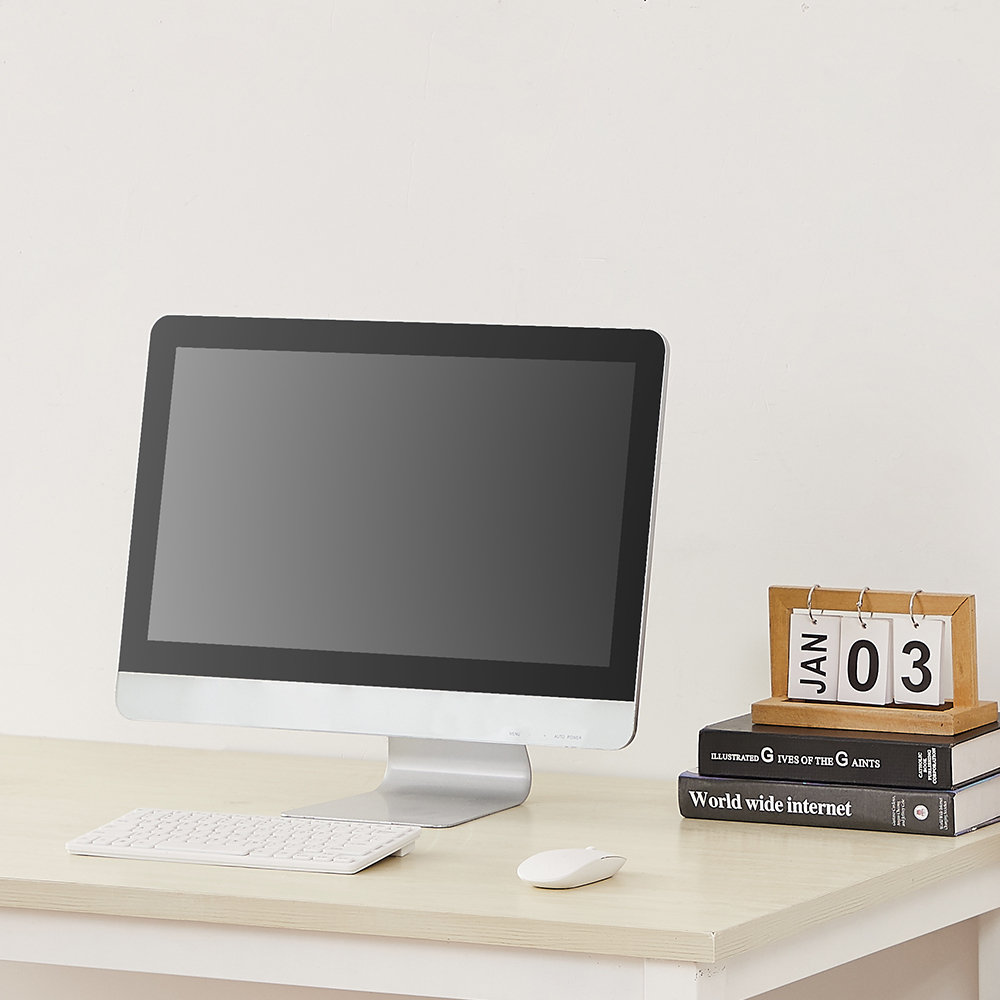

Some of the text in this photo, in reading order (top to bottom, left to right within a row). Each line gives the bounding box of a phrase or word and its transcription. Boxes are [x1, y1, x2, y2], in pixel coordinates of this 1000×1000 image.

[800, 632, 932, 694] JAN 0 3
[711, 752, 760, 762] ILLUSTRATED
[800, 754, 814, 765] OF
[815, 756, 834, 766] THE
[689, 791, 852, 817] World wide internet
